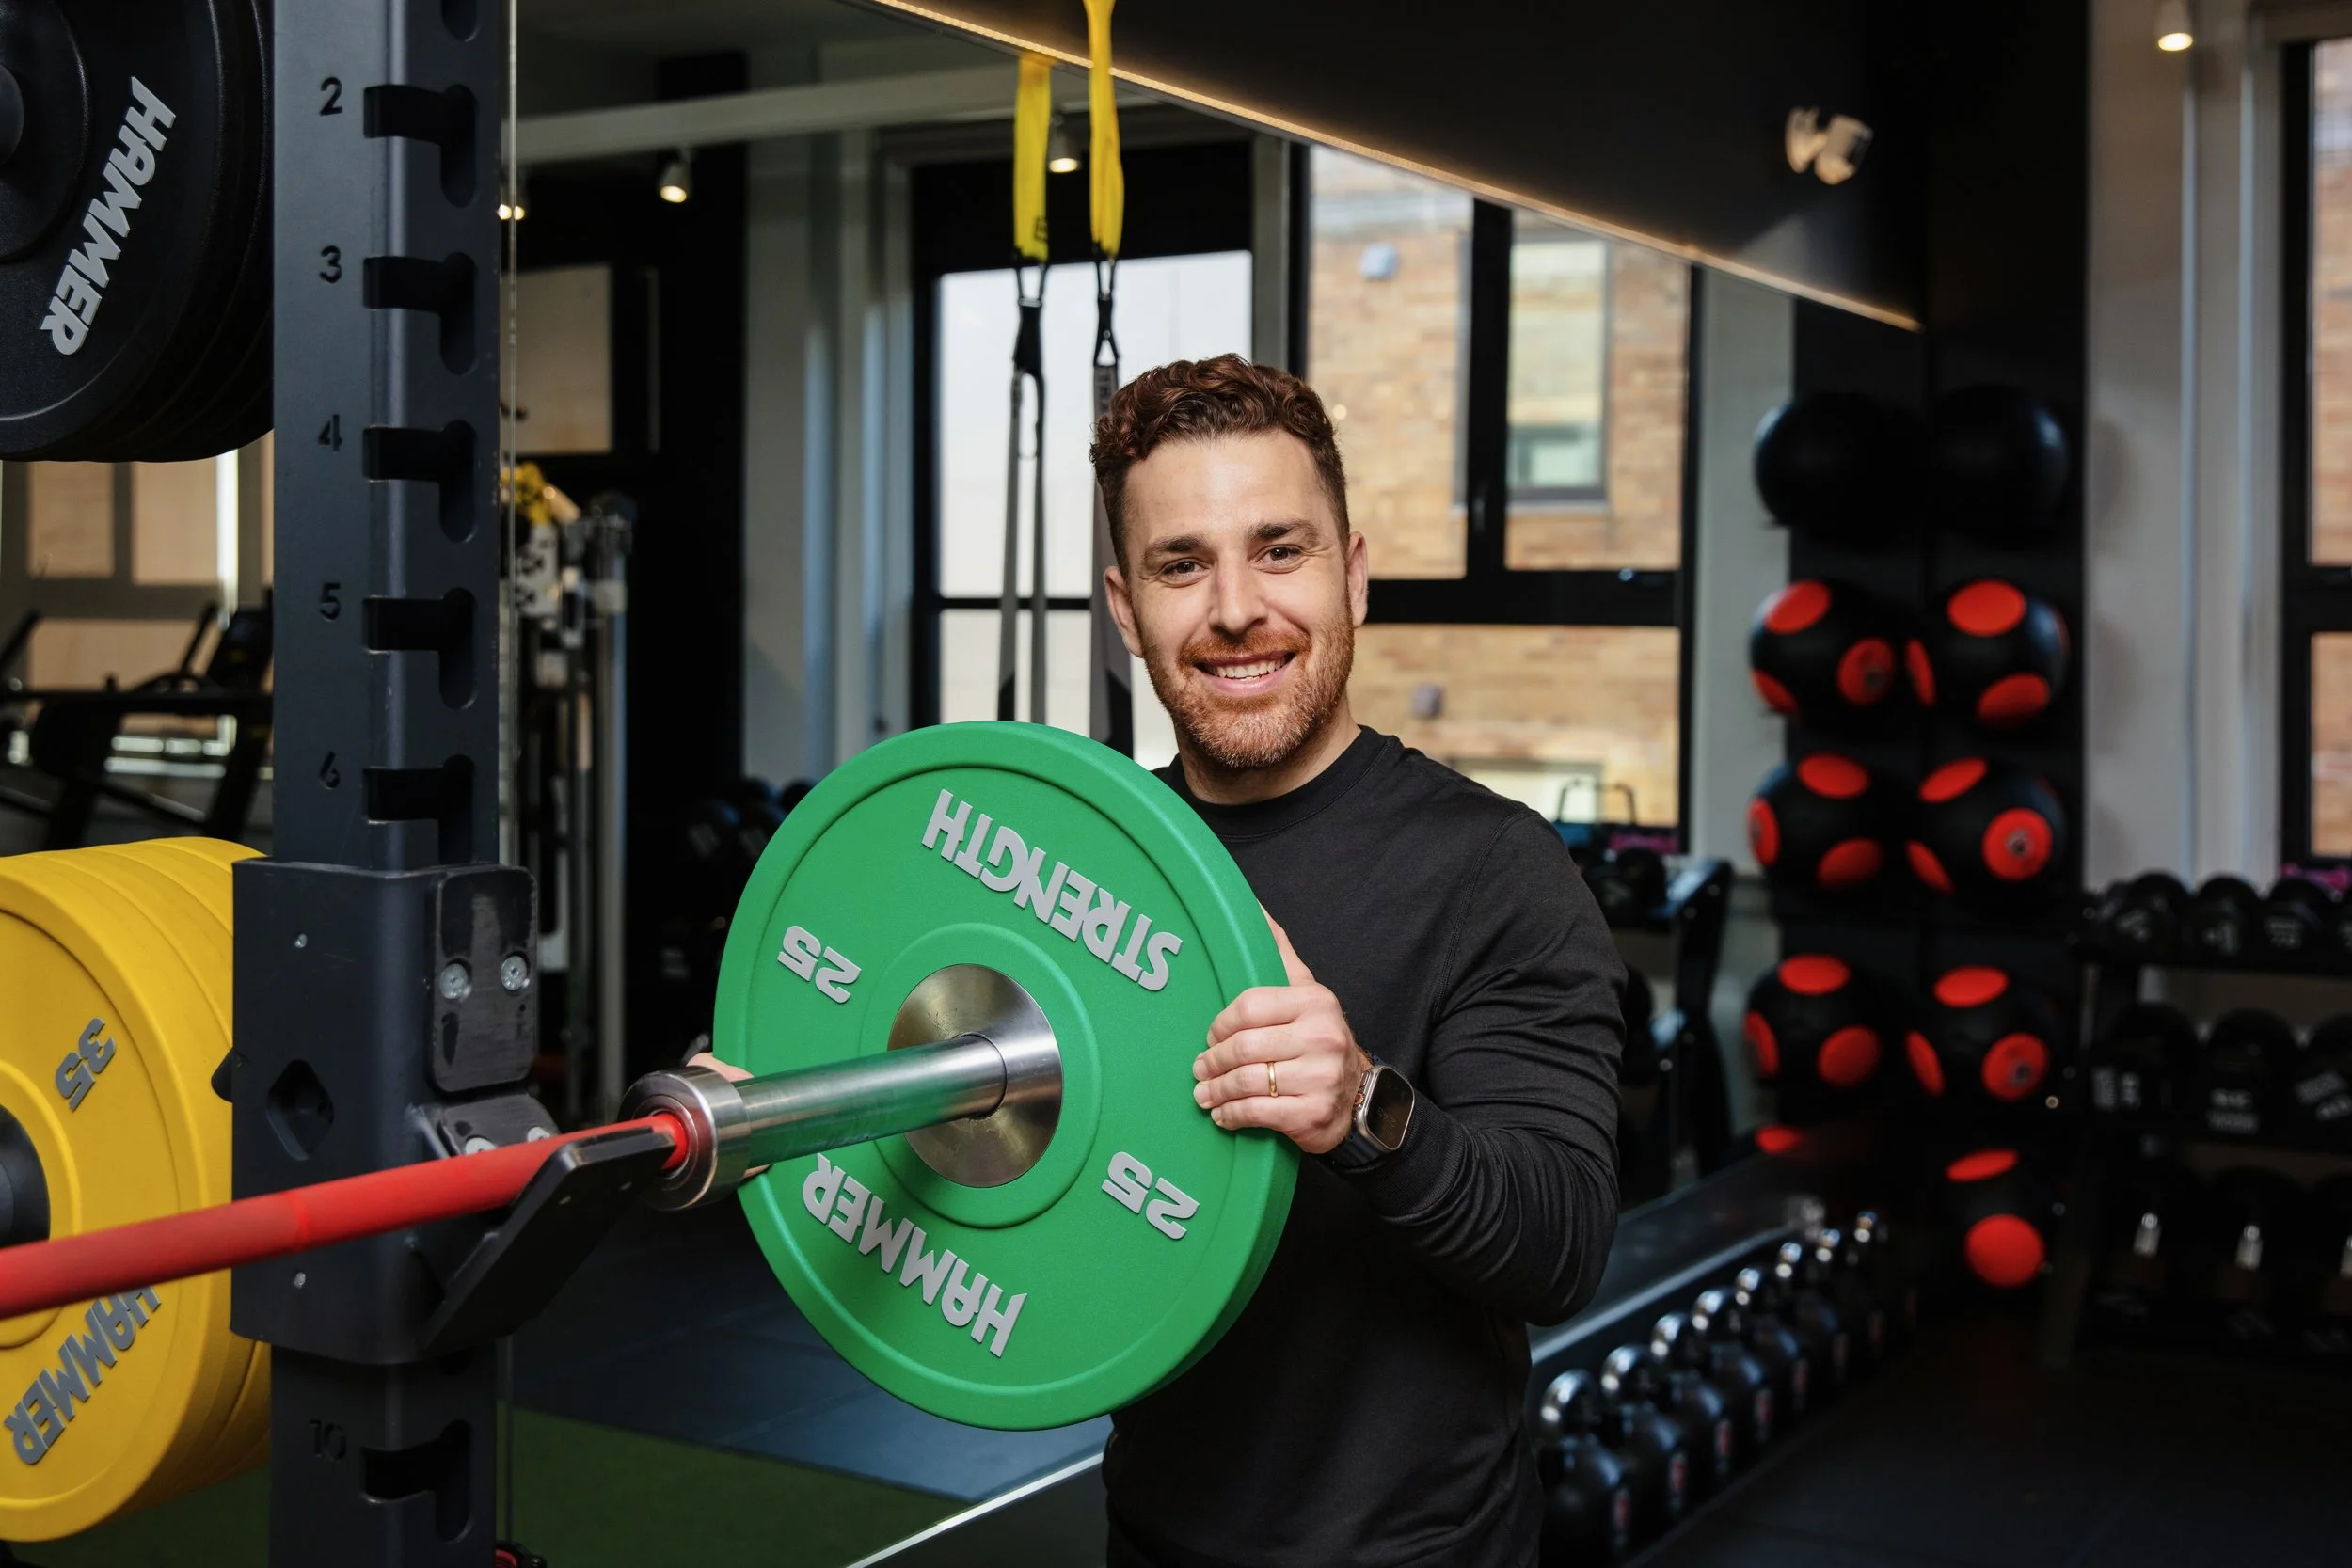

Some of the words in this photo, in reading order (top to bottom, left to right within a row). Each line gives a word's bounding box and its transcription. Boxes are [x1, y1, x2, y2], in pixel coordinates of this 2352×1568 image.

[319, 76, 343, 117] 2
[40, 76, 176, 356] HAMMER
[319, 245, 342, 284] 3
[317, 414, 342, 452] 4
[319, 581, 342, 621] 5
[318, 751, 342, 789] 6
[922, 789, 1183, 991] STRENGTH
[777, 926, 862, 1004] 25
[55, 1017, 116, 1111] 35
[1102, 1152, 1200, 1240] 25
[803, 1153, 1027, 1358] HAMMER
[309, 1418, 347, 1462] 10
